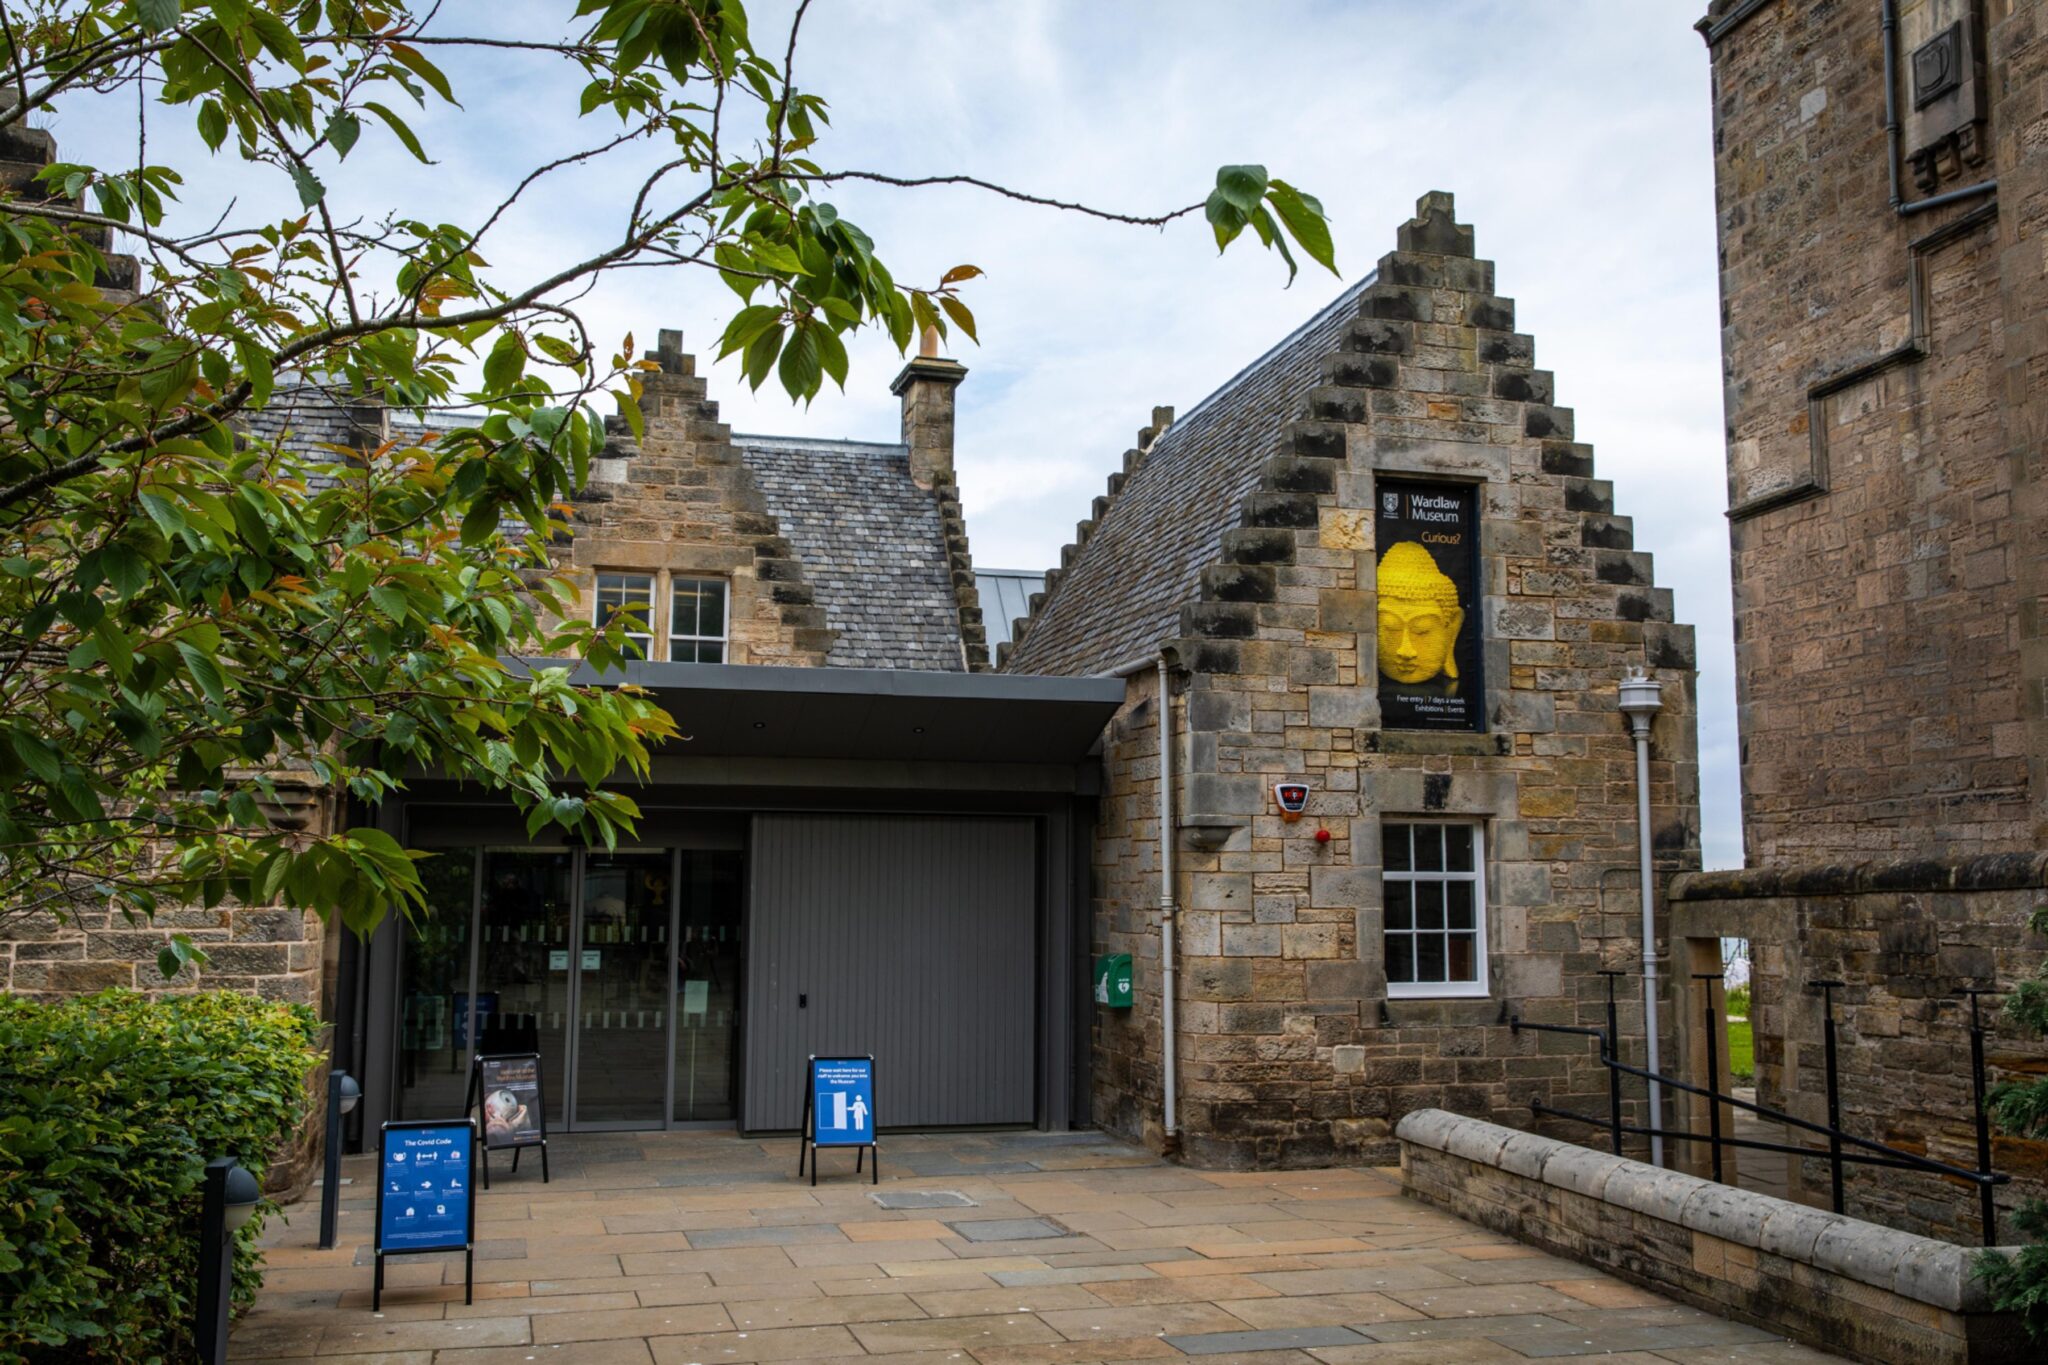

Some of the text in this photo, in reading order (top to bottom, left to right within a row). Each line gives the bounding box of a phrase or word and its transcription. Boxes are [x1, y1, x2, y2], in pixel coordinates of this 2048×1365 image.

[1411, 494, 1460, 510] Wardlaw
[1412, 508, 1459, 523] Museum
[1421, 531, 1461, 545] Curious?
[1396, 694, 1409, 703] Free
[1409, 695, 1424, 705] entry
[1432, 697, 1445, 705] days
[1414, 704, 1465, 714] Exhibitions Events
[404, 1137, 452, 1147] The Covid Code
